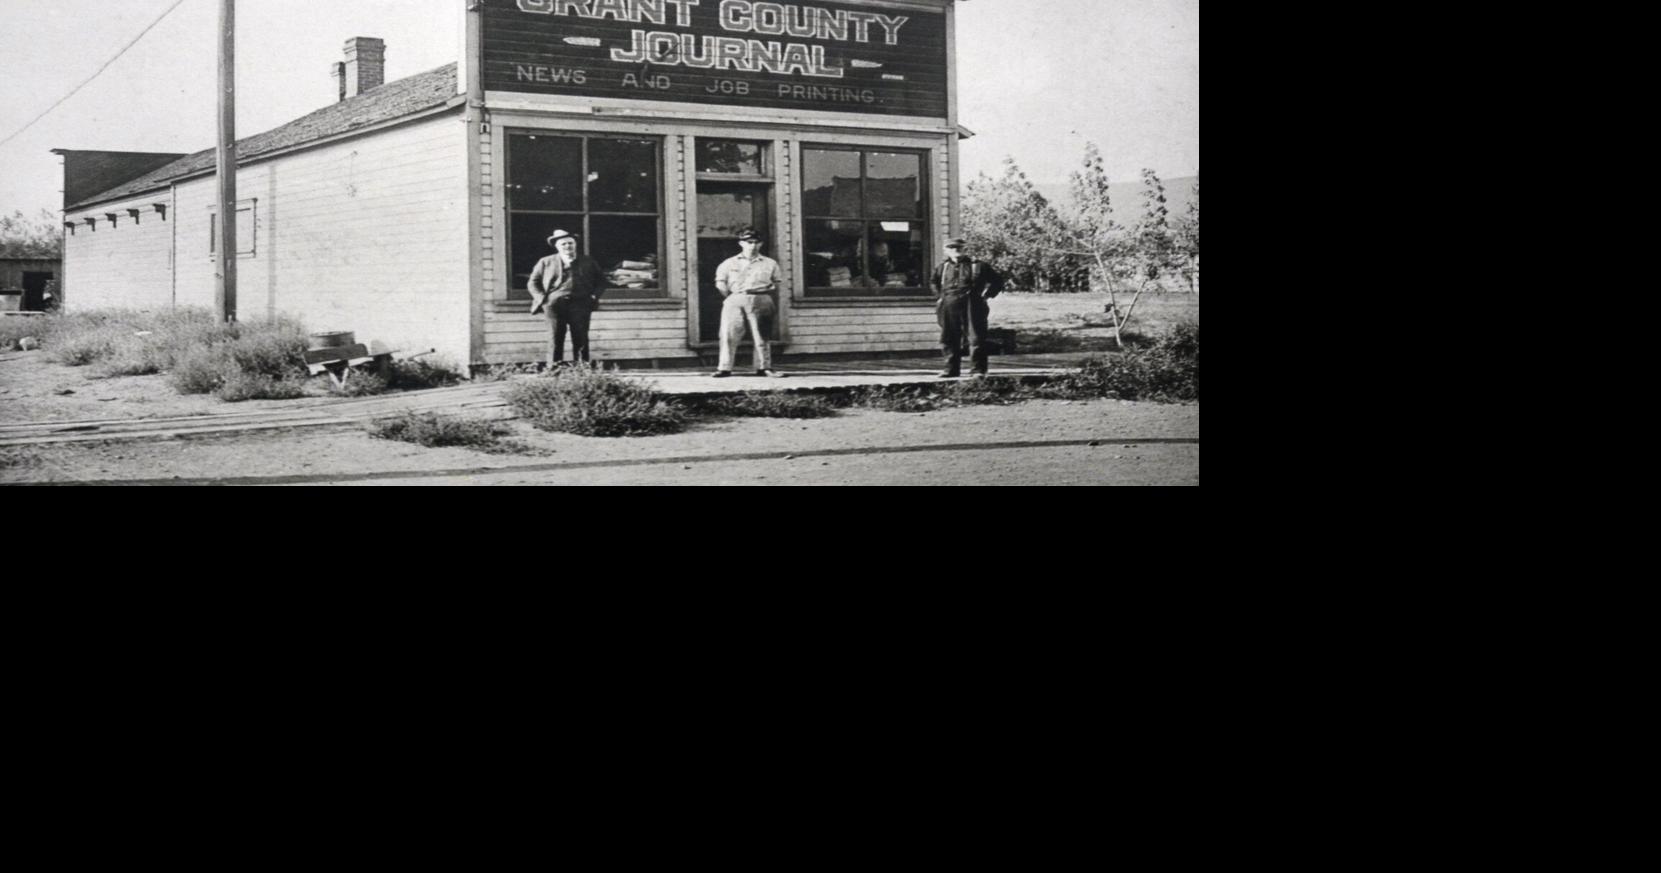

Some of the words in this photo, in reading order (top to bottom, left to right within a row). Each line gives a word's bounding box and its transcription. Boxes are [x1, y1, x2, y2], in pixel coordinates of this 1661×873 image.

[719, 0, 909, 45] COUNTY
[610, 29, 844, 78] JOURNAL
[517, 65, 587, 85] NEWS
[621, 72, 671, 90] AND
[705, 79, 750, 95] JOB
[778, 83, 884, 103] PRINTING.
